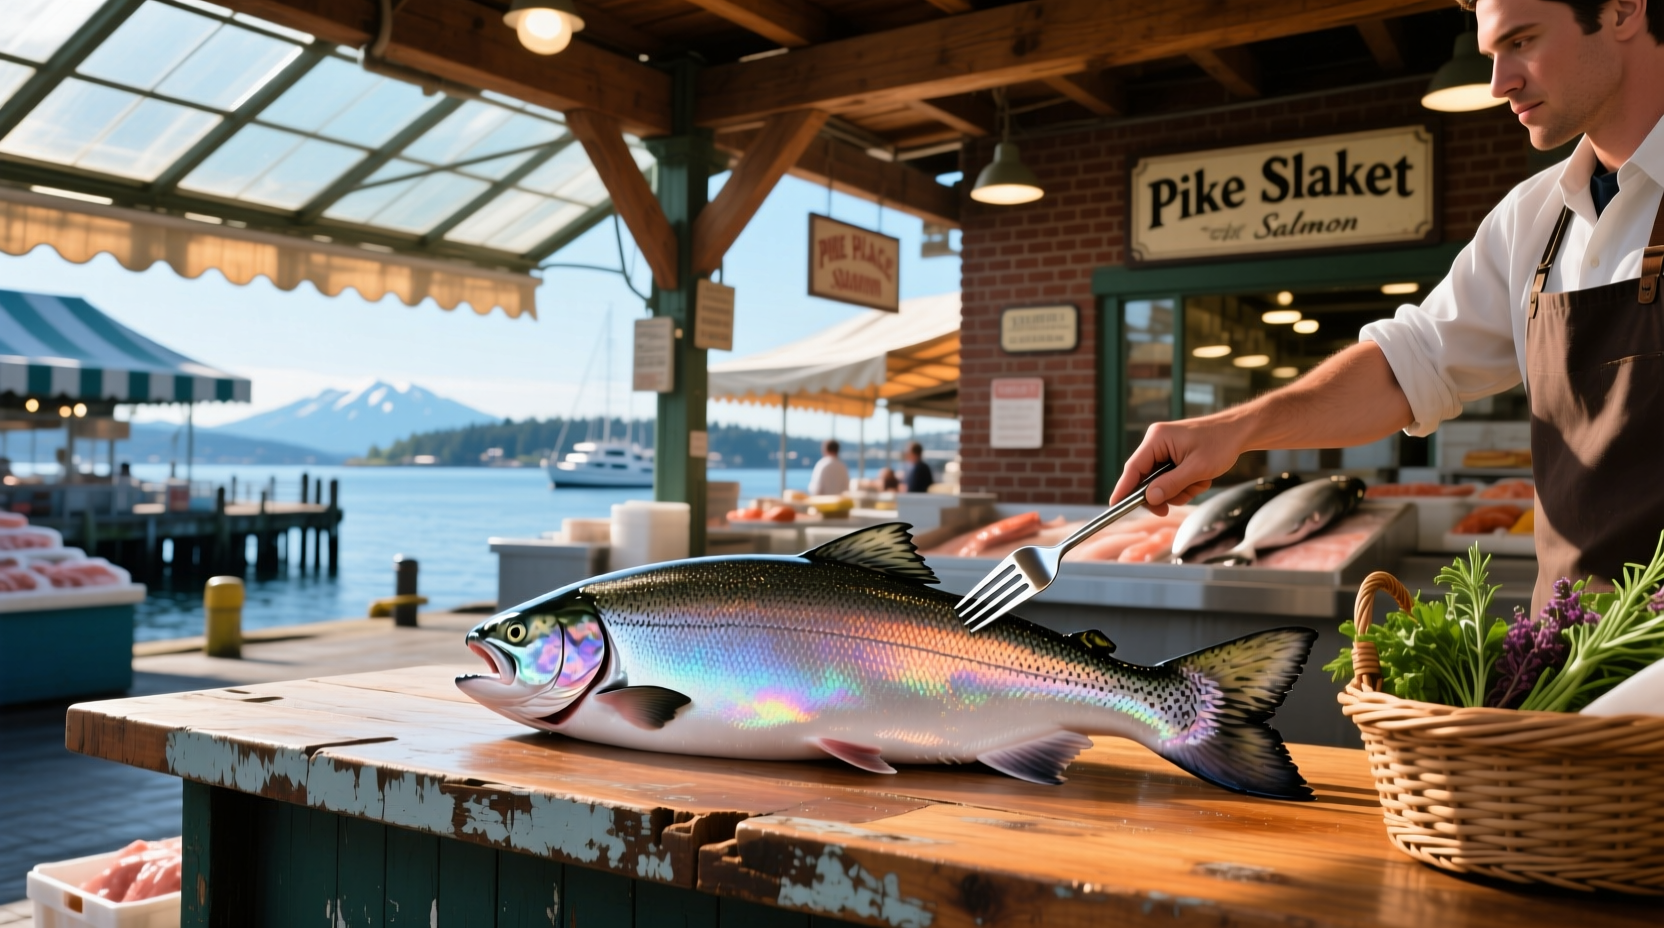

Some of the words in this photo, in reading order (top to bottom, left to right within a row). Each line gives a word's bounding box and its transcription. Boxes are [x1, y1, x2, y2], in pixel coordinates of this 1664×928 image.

[1148, 168, 1246, 230] Pike
[1261, 148, 1414, 203] Slaket
[1254, 211, 1358, 240] Salmon
